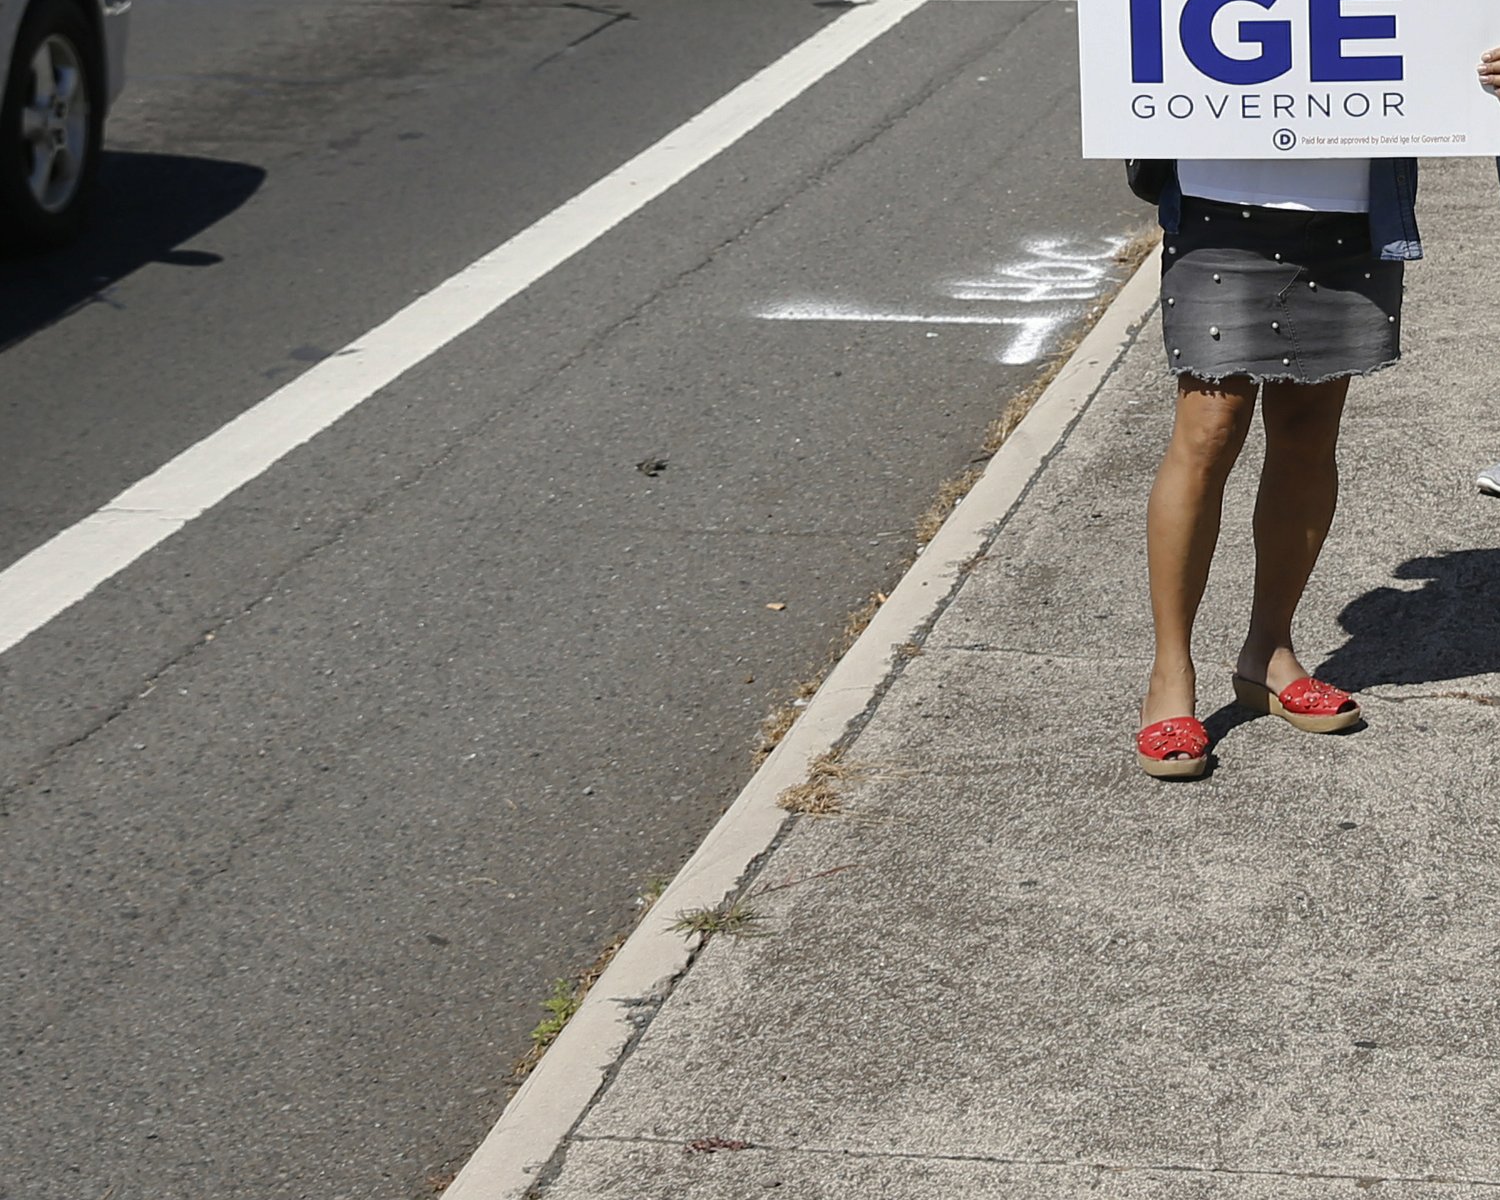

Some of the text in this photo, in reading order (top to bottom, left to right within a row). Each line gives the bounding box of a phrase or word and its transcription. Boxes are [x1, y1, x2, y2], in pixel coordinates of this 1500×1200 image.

[1131, 92, 1405, 119] GOVERNOR
[1302, 136, 1315, 144] Paid
[1317, 136, 1325, 144] for
[1327, 136, 1338, 144] and
[1340, 136, 1369, 145] approved
[1371, 136, 1379, 145] by
[1381, 135, 1398, 144] David
[1400, 135, 1409, 145] Ige
[1411, 135, 1420, 143] for
[1422, 135, 1450, 143] Governor
